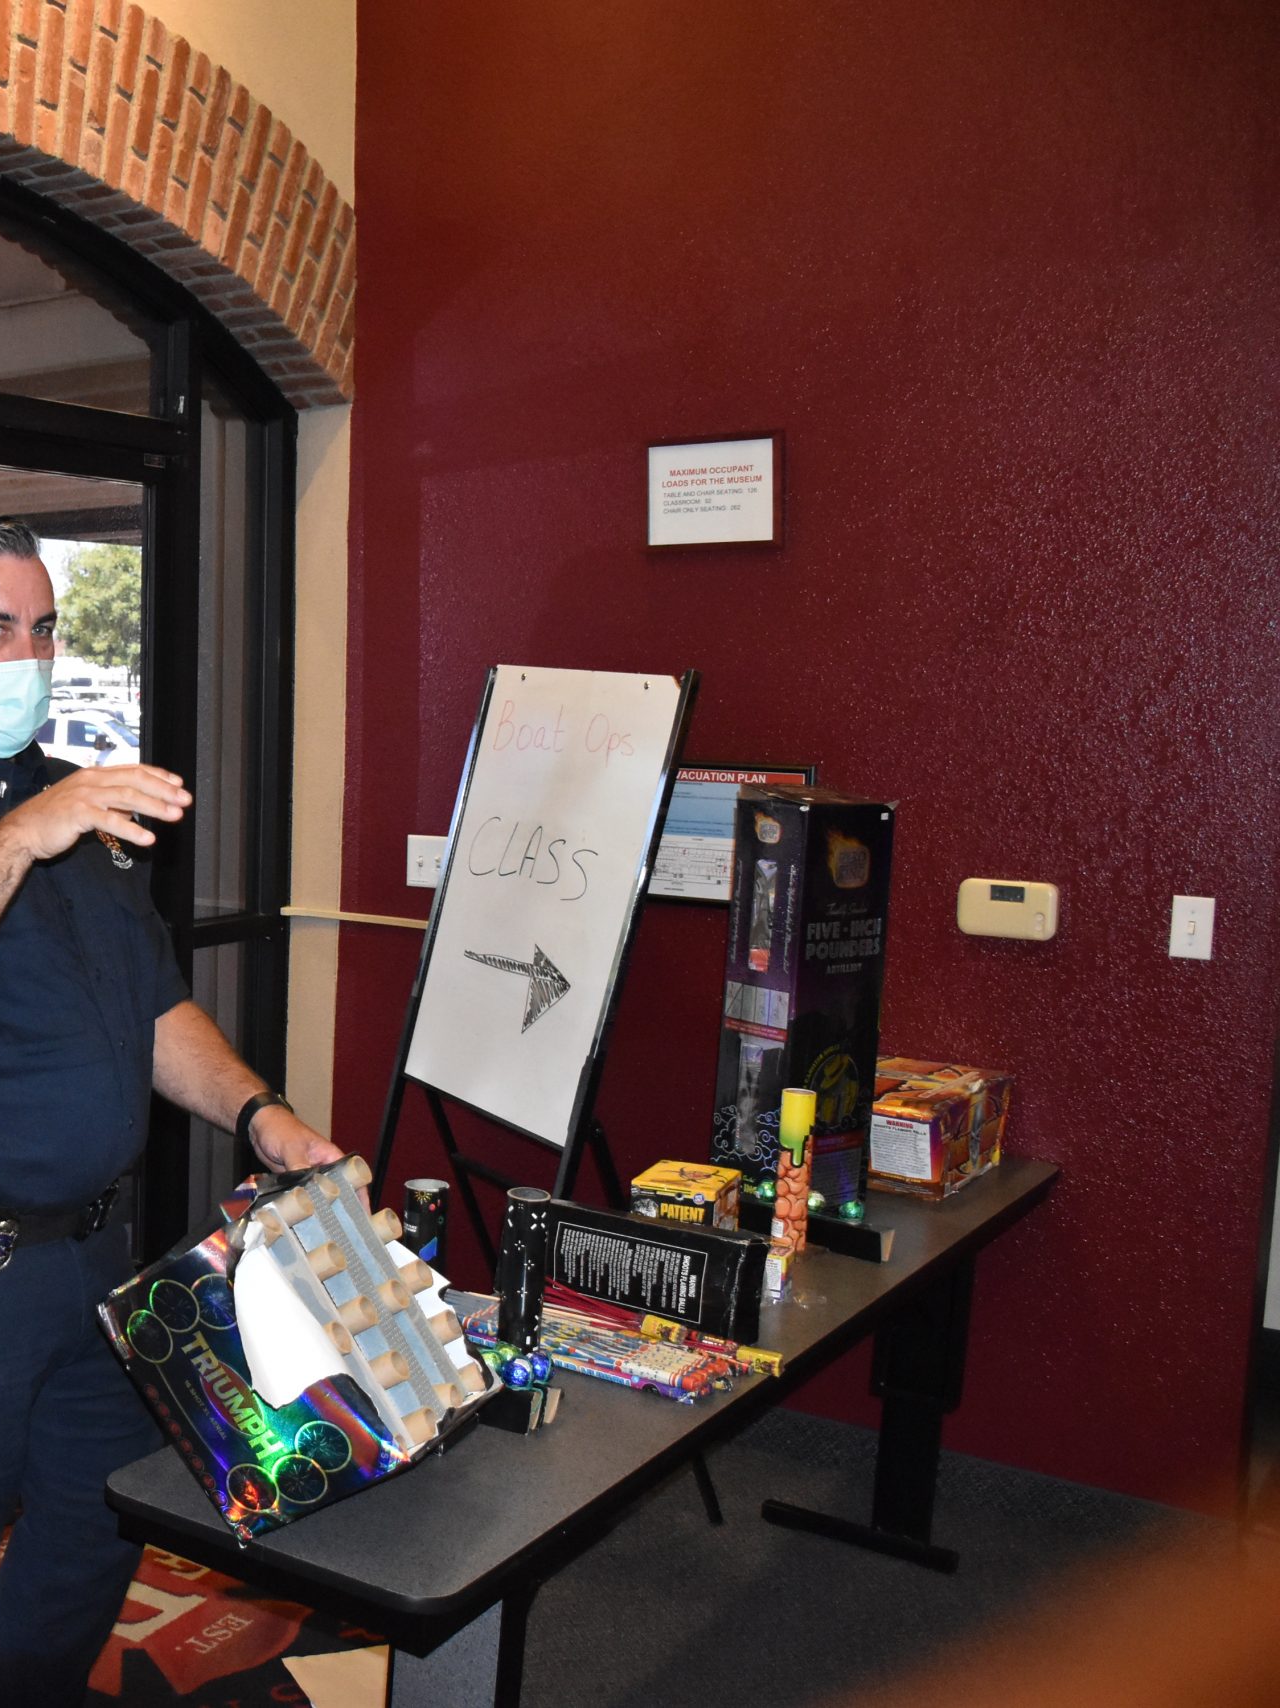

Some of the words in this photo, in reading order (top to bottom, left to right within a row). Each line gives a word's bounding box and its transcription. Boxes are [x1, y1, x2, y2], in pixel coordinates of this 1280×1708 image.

[661, 480, 689, 488] LOADS
[691, 478, 707, 486] FOR
[710, 477, 725, 485] THE
[726, 475, 762, 484] MUSEUM
[669, 467, 707, 477] MAXIMUM
[709, 464, 754, 475] OCCUPANT
[493, 700, 565, 752] Boat
[585, 712, 635, 768] Ops
[676, 770, 735, 782] VACUATION
[737, 773, 767, 783] PLAN
[468, 816, 599, 901] CLASS
[805, 937, 880, 960] POUNDERS
[885, 1119, 914, 1129] WARNING
[660, 1202, 705, 1224] PATIENT
[680, 1254, 691, 1276] SHOOTS
[679, 1275, 688, 1297] FLAMING
[688, 1274, 697, 1298] WARNING
[677, 1297, 686, 1314] BALLS
[180, 1330, 288, 1462] TRIUMPH
[175, 1612, 255, 1655] EST.
